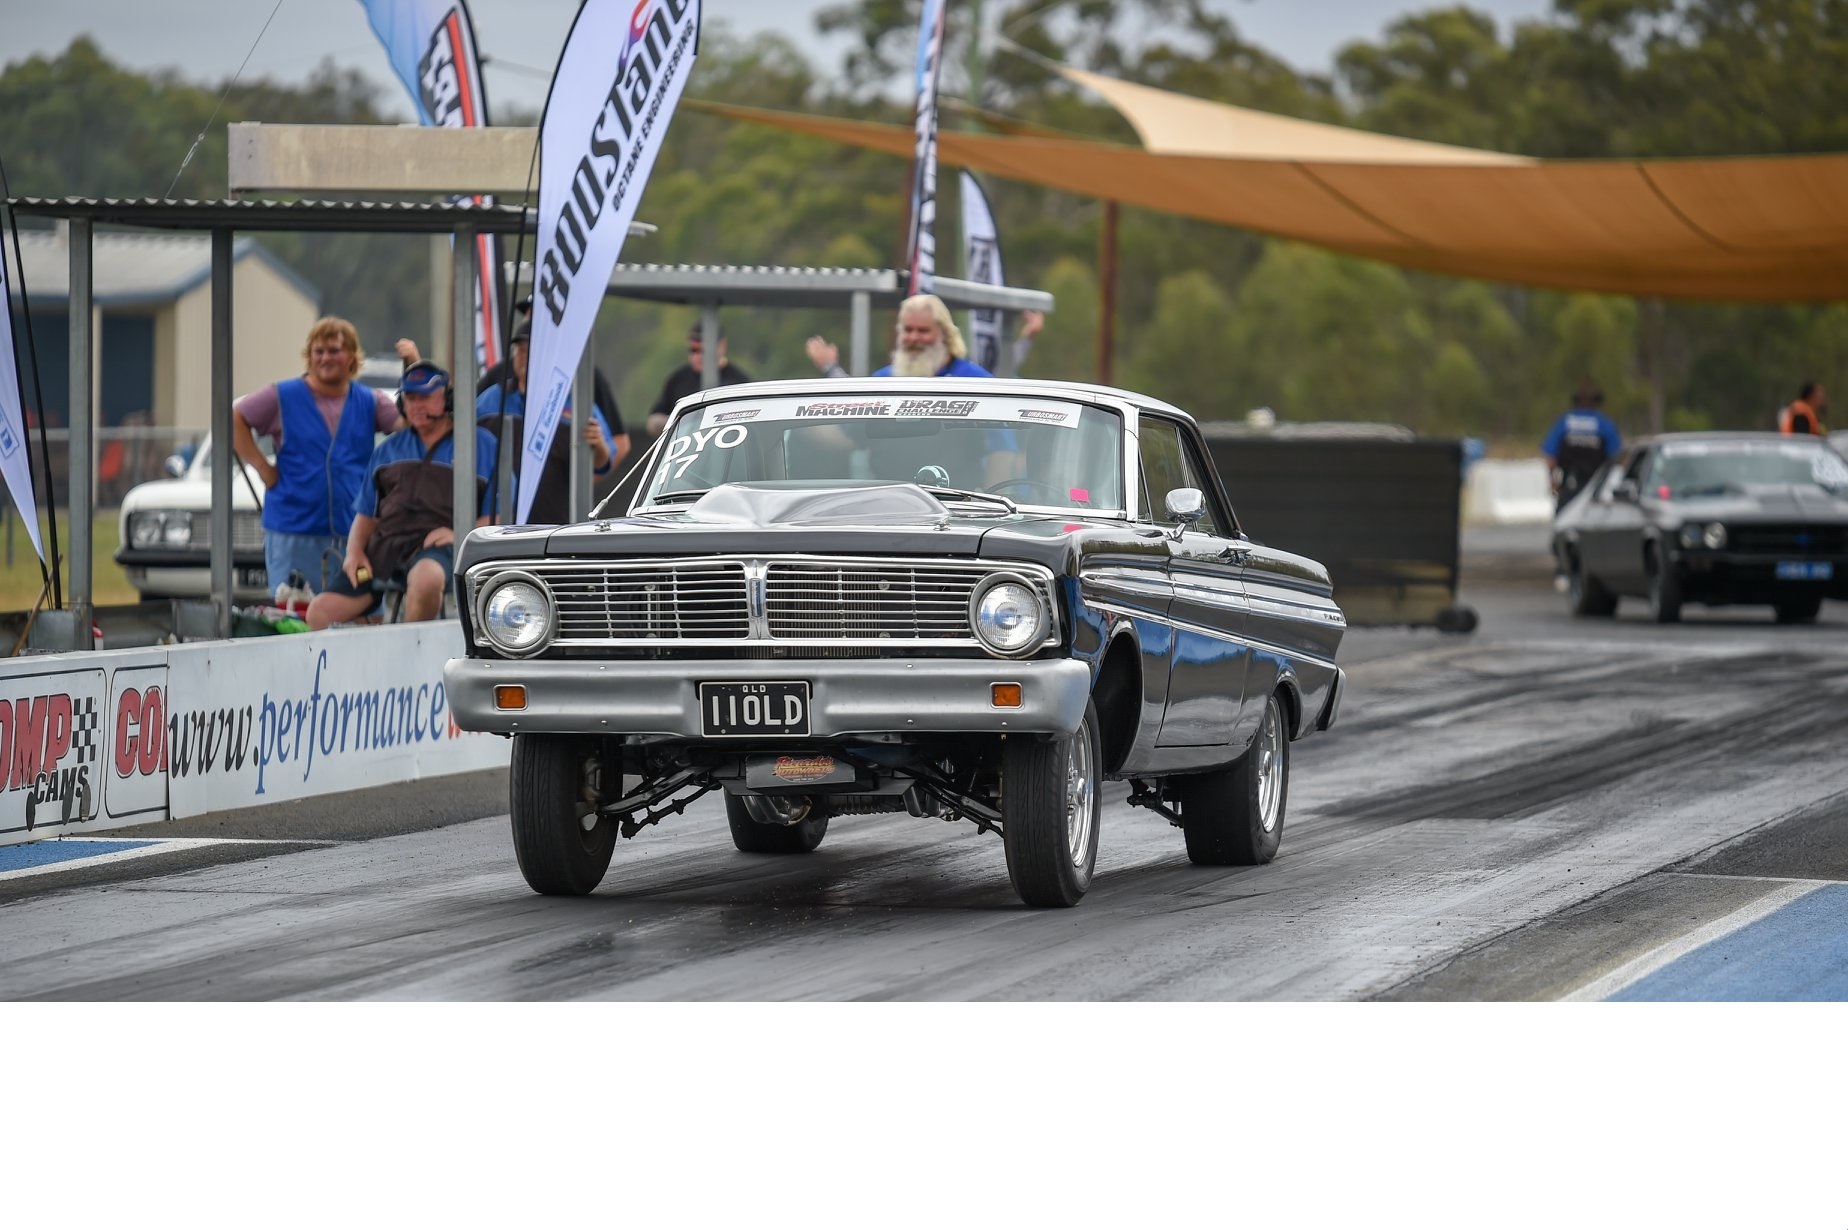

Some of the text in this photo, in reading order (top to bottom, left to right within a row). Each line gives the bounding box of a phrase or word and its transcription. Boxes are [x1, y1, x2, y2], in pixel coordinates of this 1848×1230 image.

[795, 404, 892, 417] MACHINE
[899, 400, 967, 409] DRAG
[664, 424, 748, 464] DYO
[657, 453, 700, 486] 17
[742, 685, 767, 693] QLD
[115, 685, 168, 779] CO
[33, 765, 90, 805] CAMS
